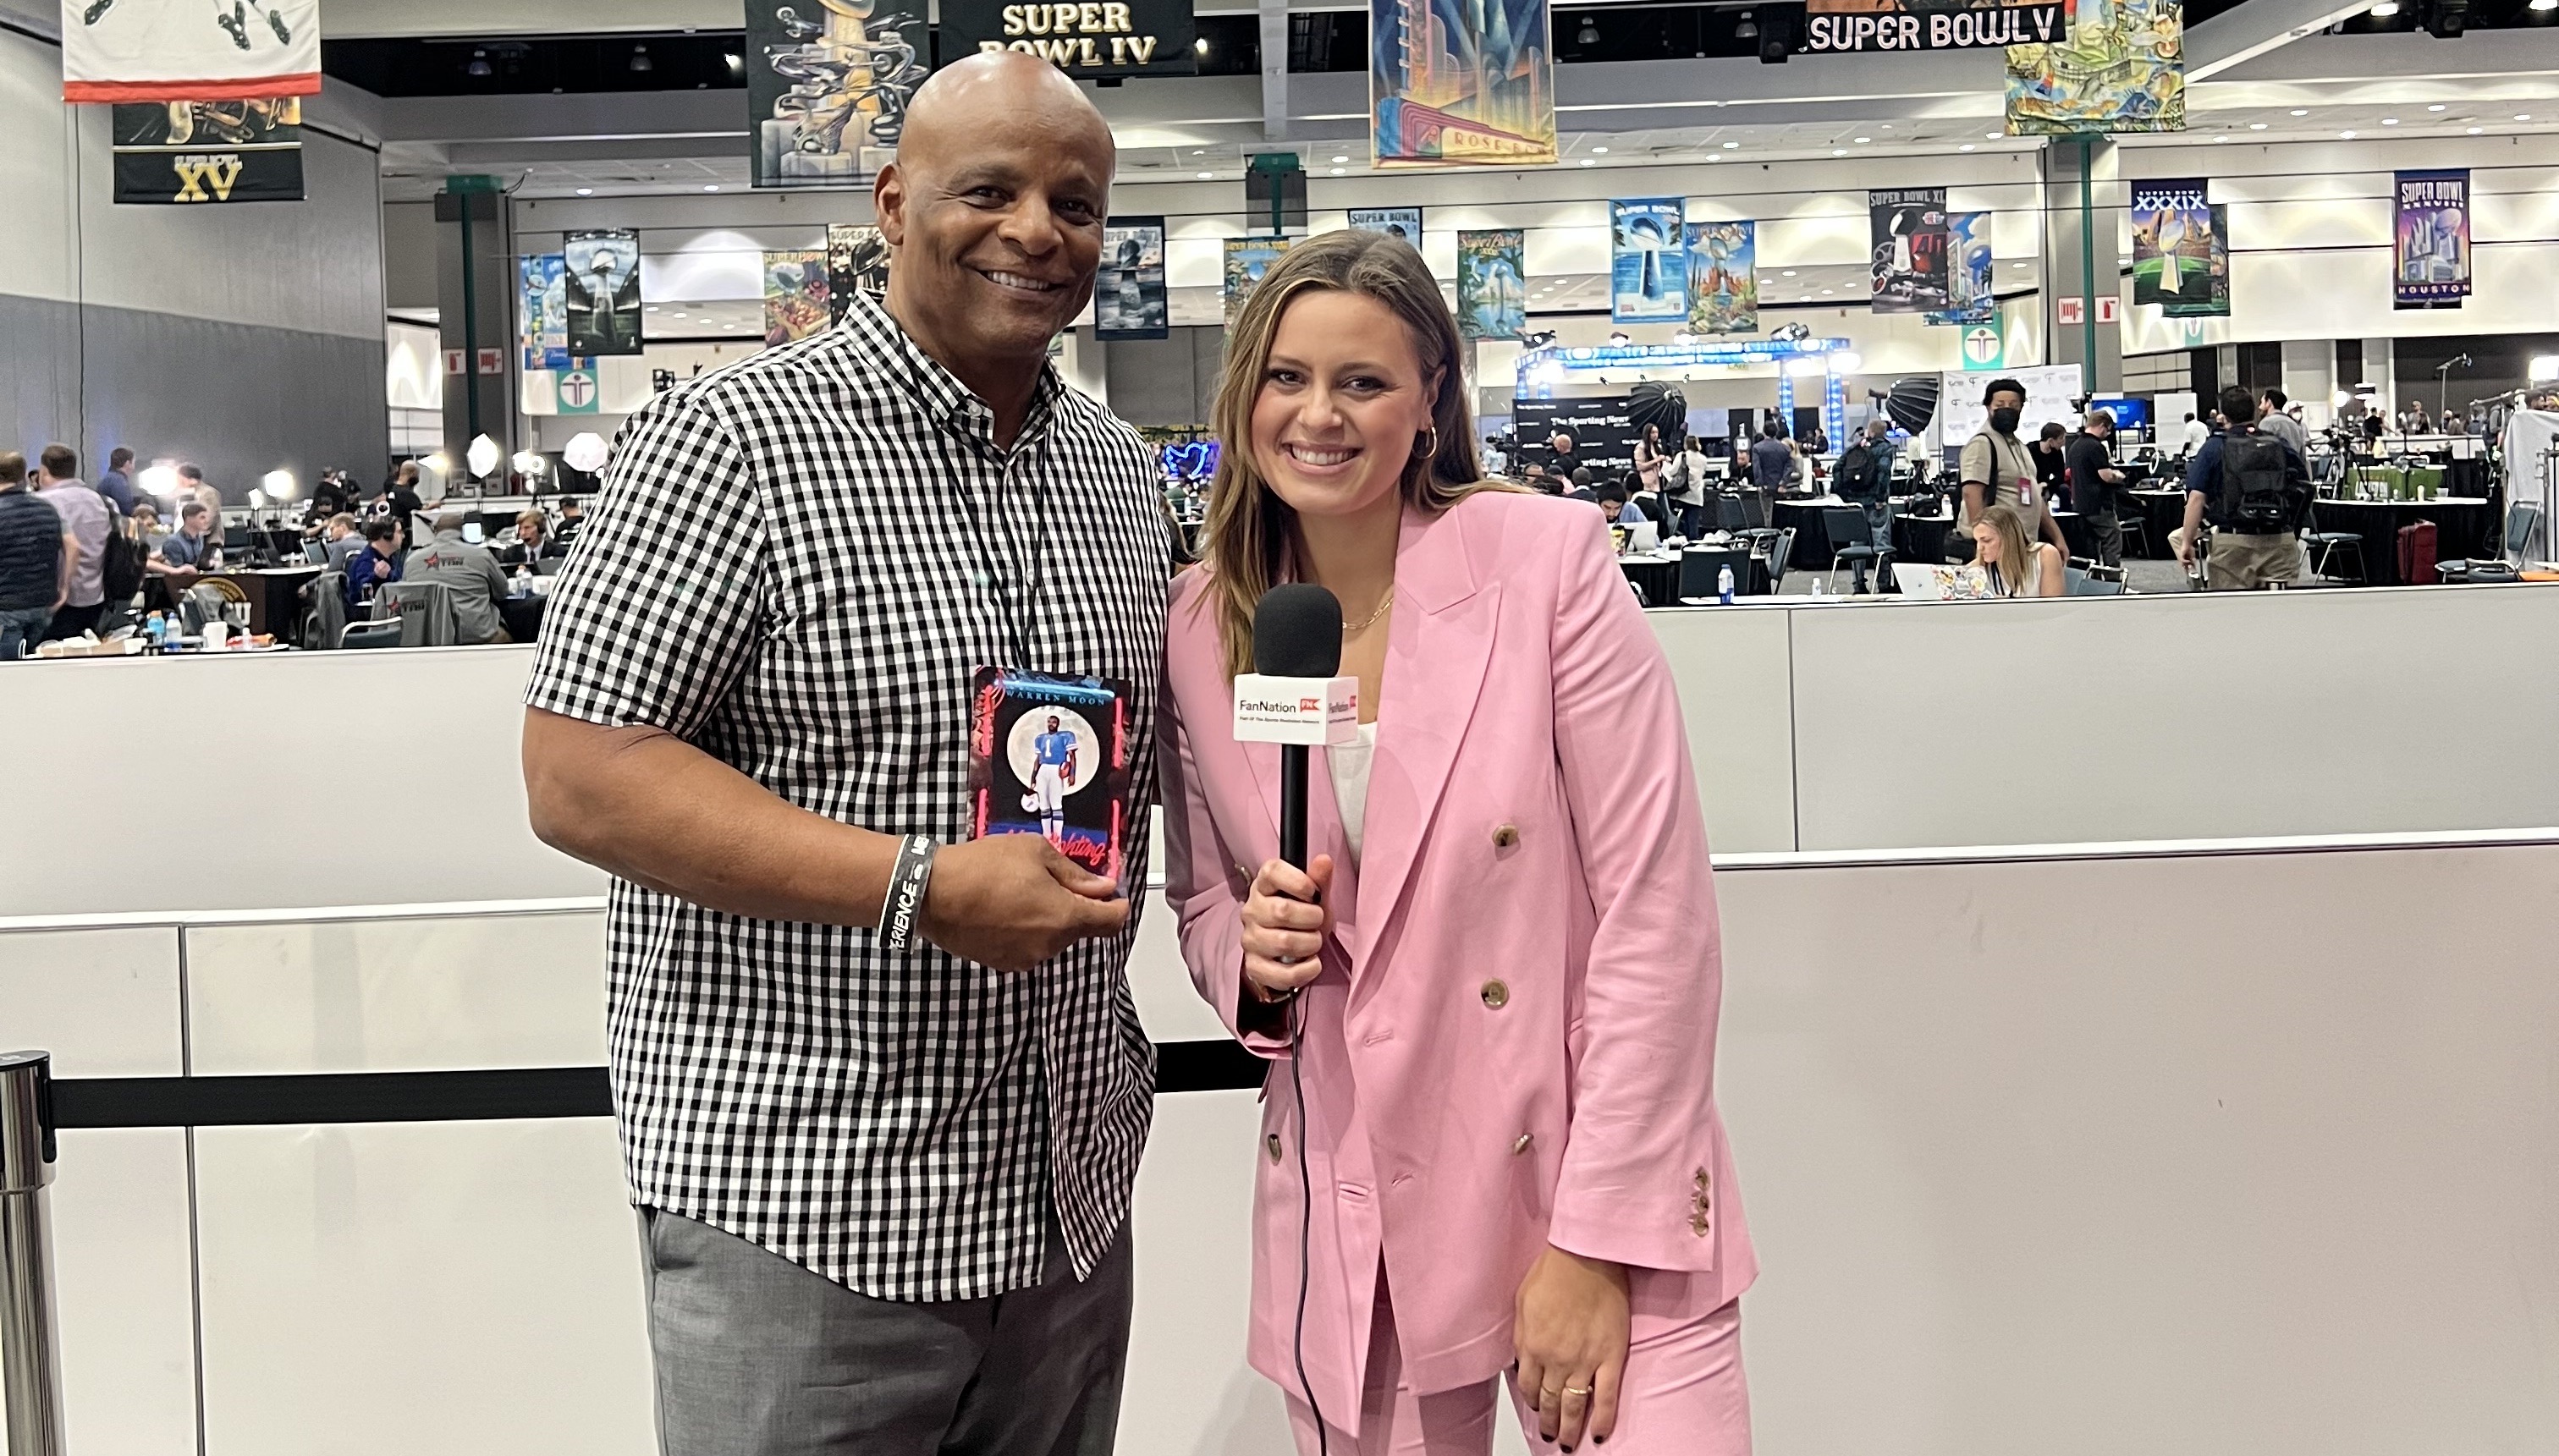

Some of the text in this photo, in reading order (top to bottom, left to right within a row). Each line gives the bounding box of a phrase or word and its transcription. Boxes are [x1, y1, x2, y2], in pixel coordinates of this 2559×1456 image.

[1002, 2, 1132, 36] SUPER
[1809, 7, 2055, 51] SUPER BOWL V
[1110, 36, 1158, 65] IV
[1455, 131, 1502, 151] ROSE
[173, 162, 243, 201] XV
[1870, 191, 1901, 207] SUPER
[1903, 190, 1930, 202] BOWL
[1933, 190, 1945, 203] XL
[2401, 180, 2463, 203] SUPER BOWL
[2133, 195, 2208, 212] XXXIX
[1351, 212, 1417, 224] SUPER BOWL
[2397, 283, 2470, 294] HOUSTON
[1568, 416, 1606, 426] Sporting
[1609, 457, 1632, 466] News
[1006, 690, 1105, 706] WARREN MOON
[1239, 699, 1296, 713] FanNation
[1045, 739, 1052, 757] 1
